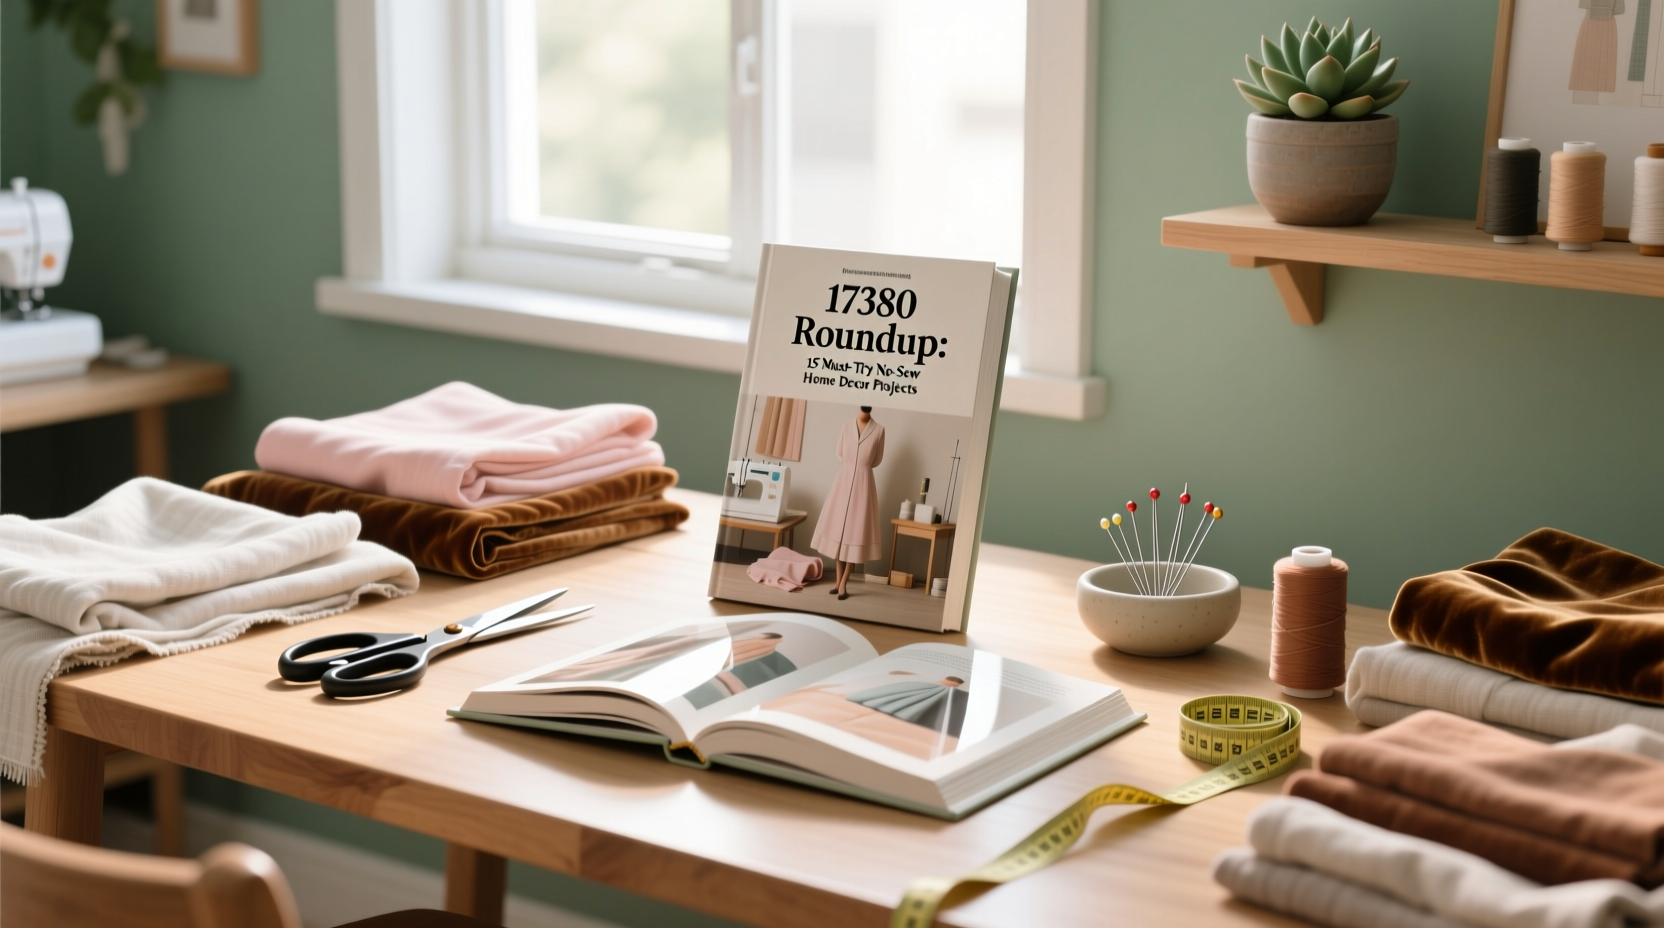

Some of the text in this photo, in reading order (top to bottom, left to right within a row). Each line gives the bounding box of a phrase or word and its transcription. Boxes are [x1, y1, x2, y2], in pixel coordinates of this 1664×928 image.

[825, 284, 917, 319] 17380
[791, 315, 948, 366] Roundup:
[803, 371, 836, 386] Home
